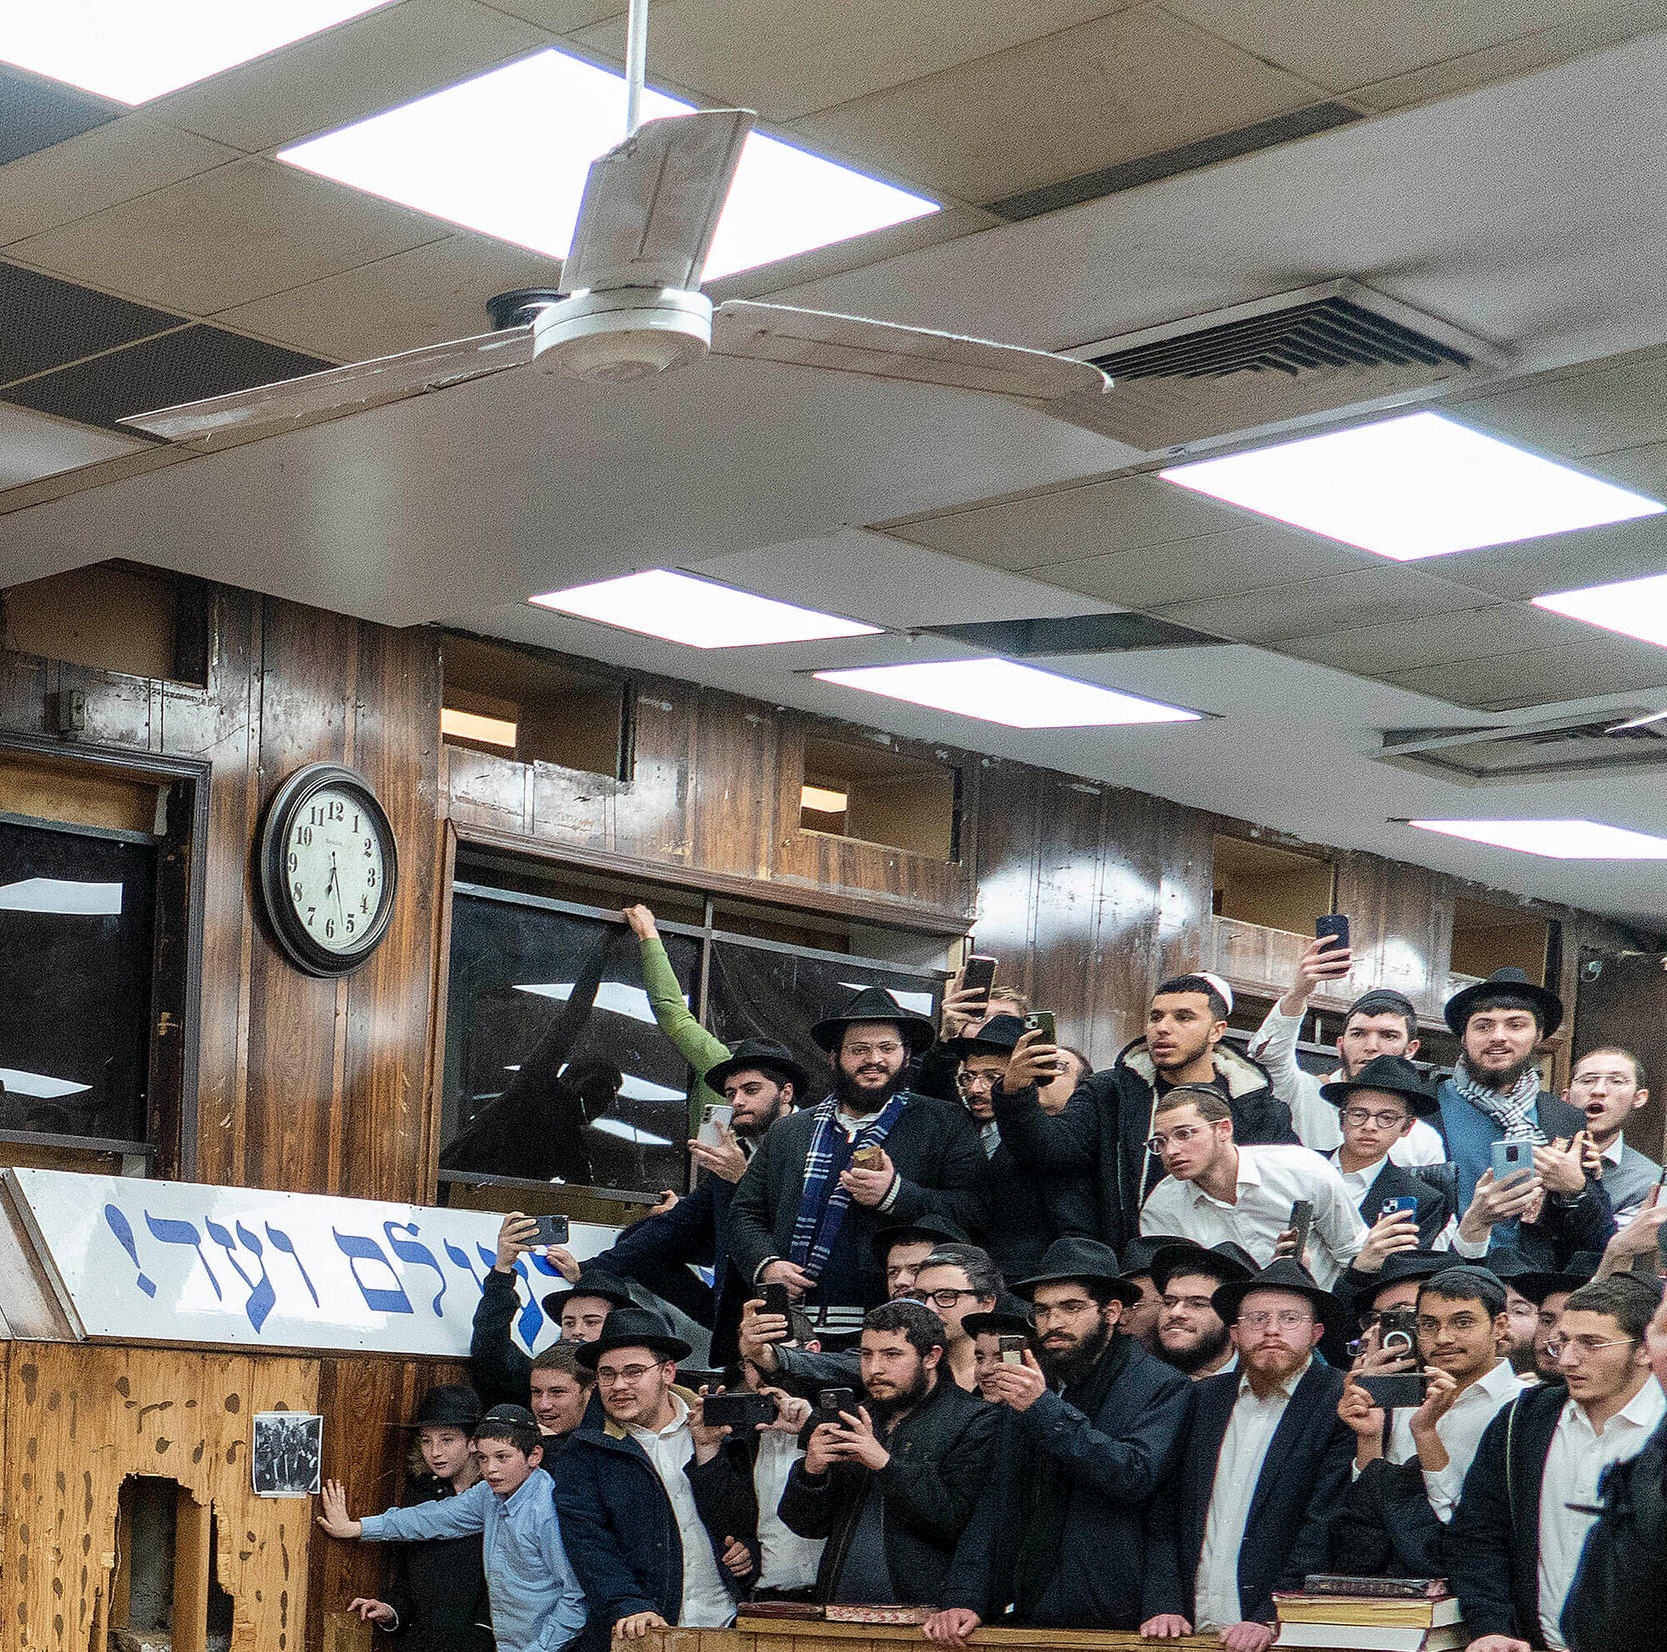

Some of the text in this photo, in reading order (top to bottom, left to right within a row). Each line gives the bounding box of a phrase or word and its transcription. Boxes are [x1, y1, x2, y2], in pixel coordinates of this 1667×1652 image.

[309, 806, 325, 827] 11
[327, 801, 344, 822] 12
[352, 815, 359, 834] 1
[296, 825, 313, 846] 10
[364, 838, 372, 858] 2
[289, 853, 298, 873] 9
[368, 868, 376, 888] 3
[293, 882, 303, 902] 8
[359, 894, 368, 915] 4
[307, 906, 316, 926] 7
[346, 913, 355, 934] 5
[325, 918, 334, 939] 6
